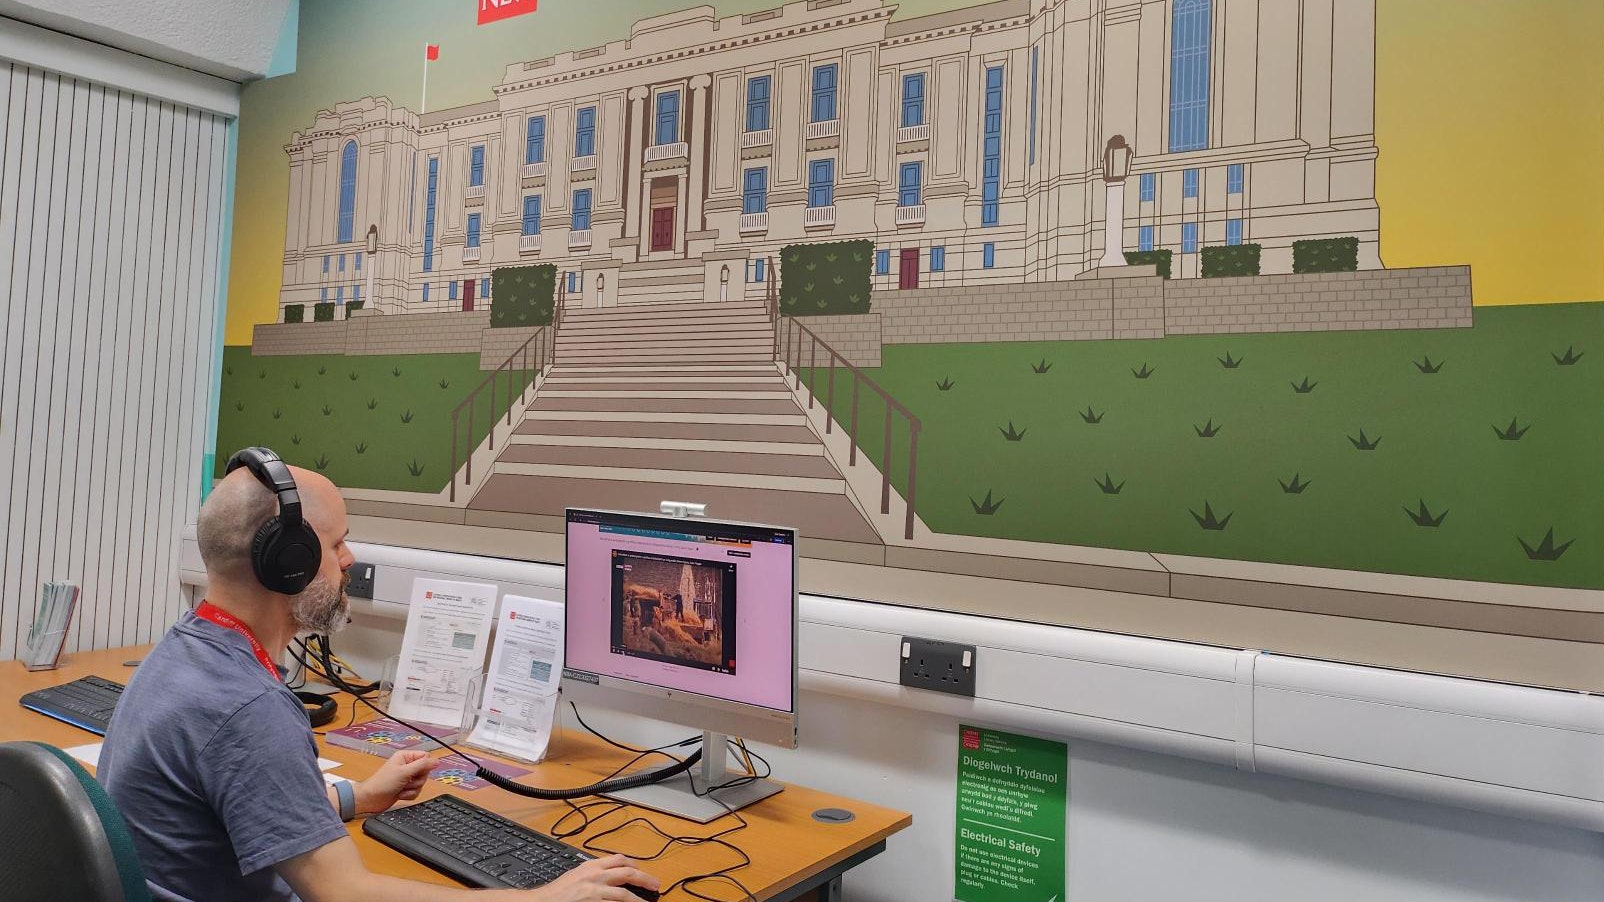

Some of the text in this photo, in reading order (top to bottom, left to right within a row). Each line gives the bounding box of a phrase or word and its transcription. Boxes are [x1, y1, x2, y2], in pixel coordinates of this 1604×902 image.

[963, 756, 1058, 783] Diogelwch Trydanol
[961, 828, 1041, 857] Electrical Safety
[968, 846, 978, 854] not
[990, 852, 1016, 863] electrical
[1017, 859, 1039, 869] devices
[1000, 879, 1019, 889] Check
